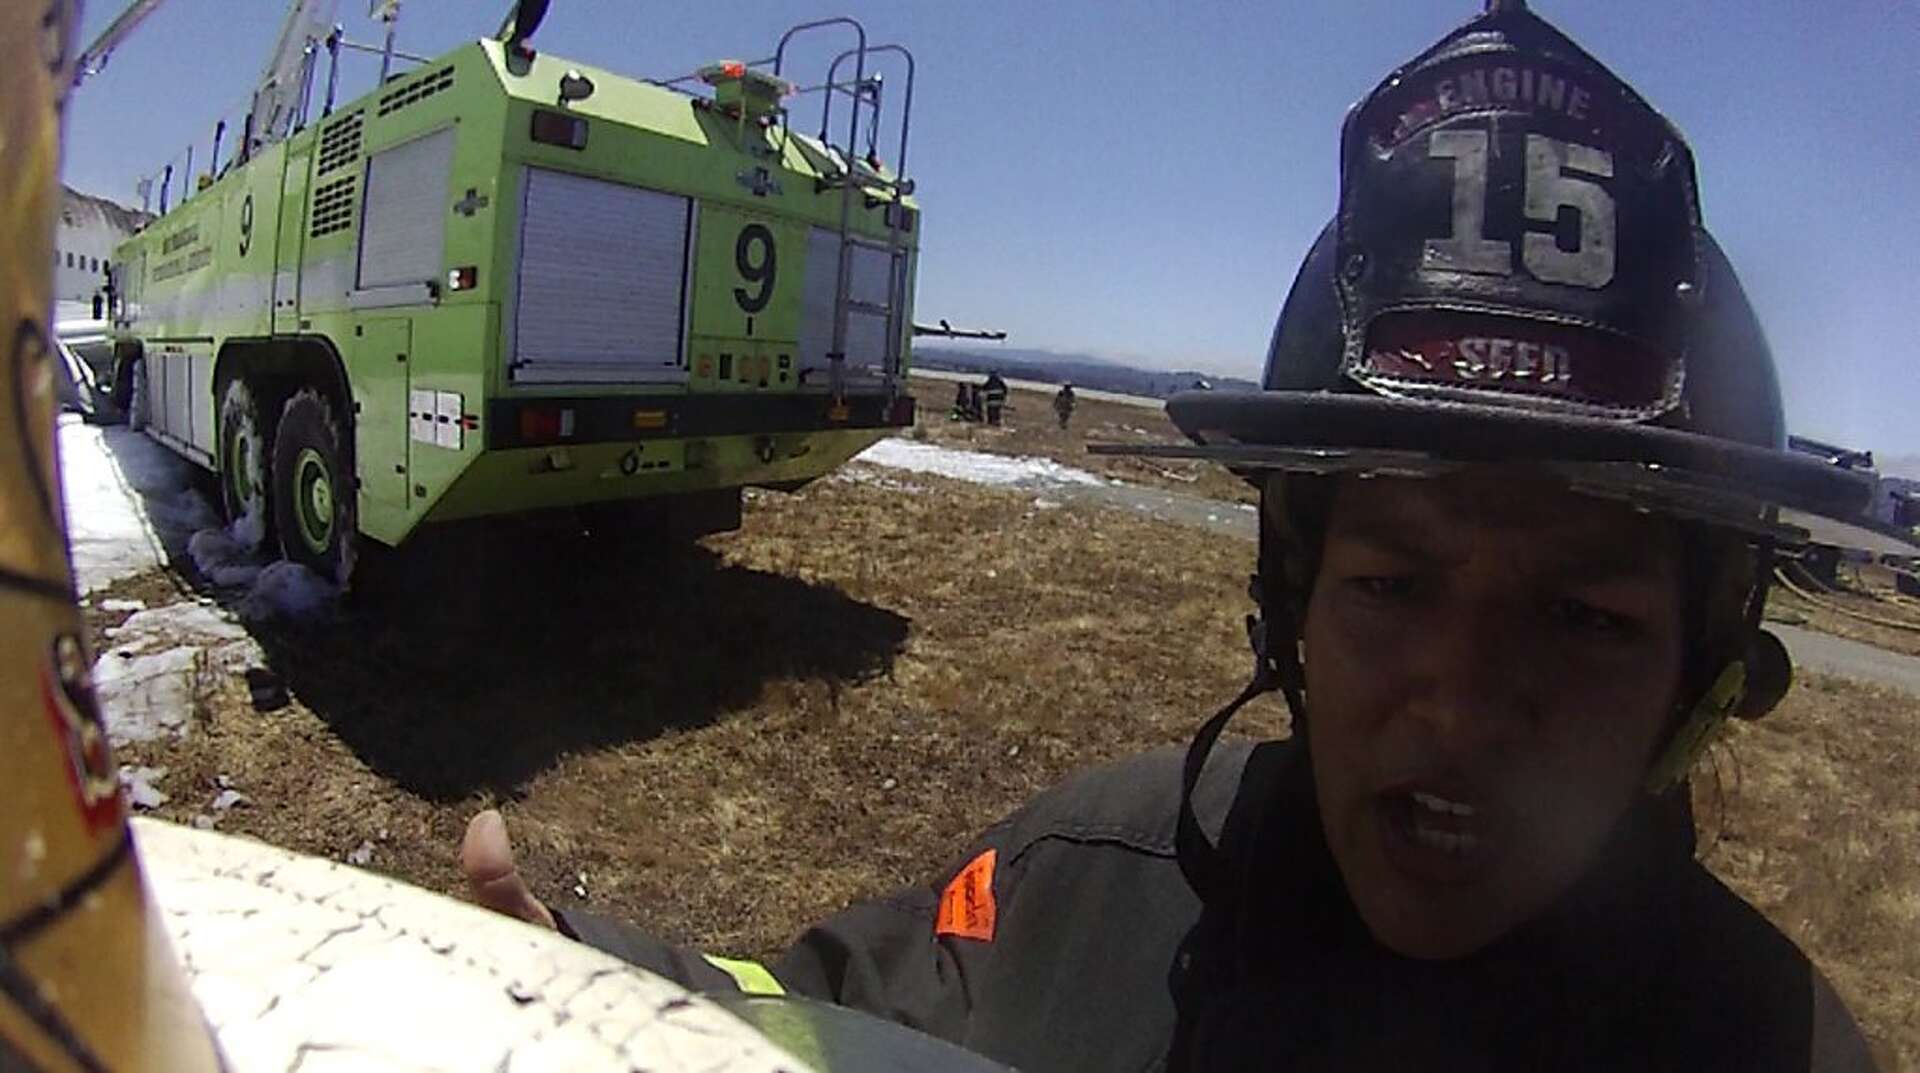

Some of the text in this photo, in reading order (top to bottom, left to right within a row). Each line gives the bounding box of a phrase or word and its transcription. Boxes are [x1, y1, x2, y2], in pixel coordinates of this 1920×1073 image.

[1438, 67, 1593, 120] ENGINE
[240, 194, 253, 257] 9
[1422, 130, 1616, 288] 15
[734, 223, 776, 314] 9
